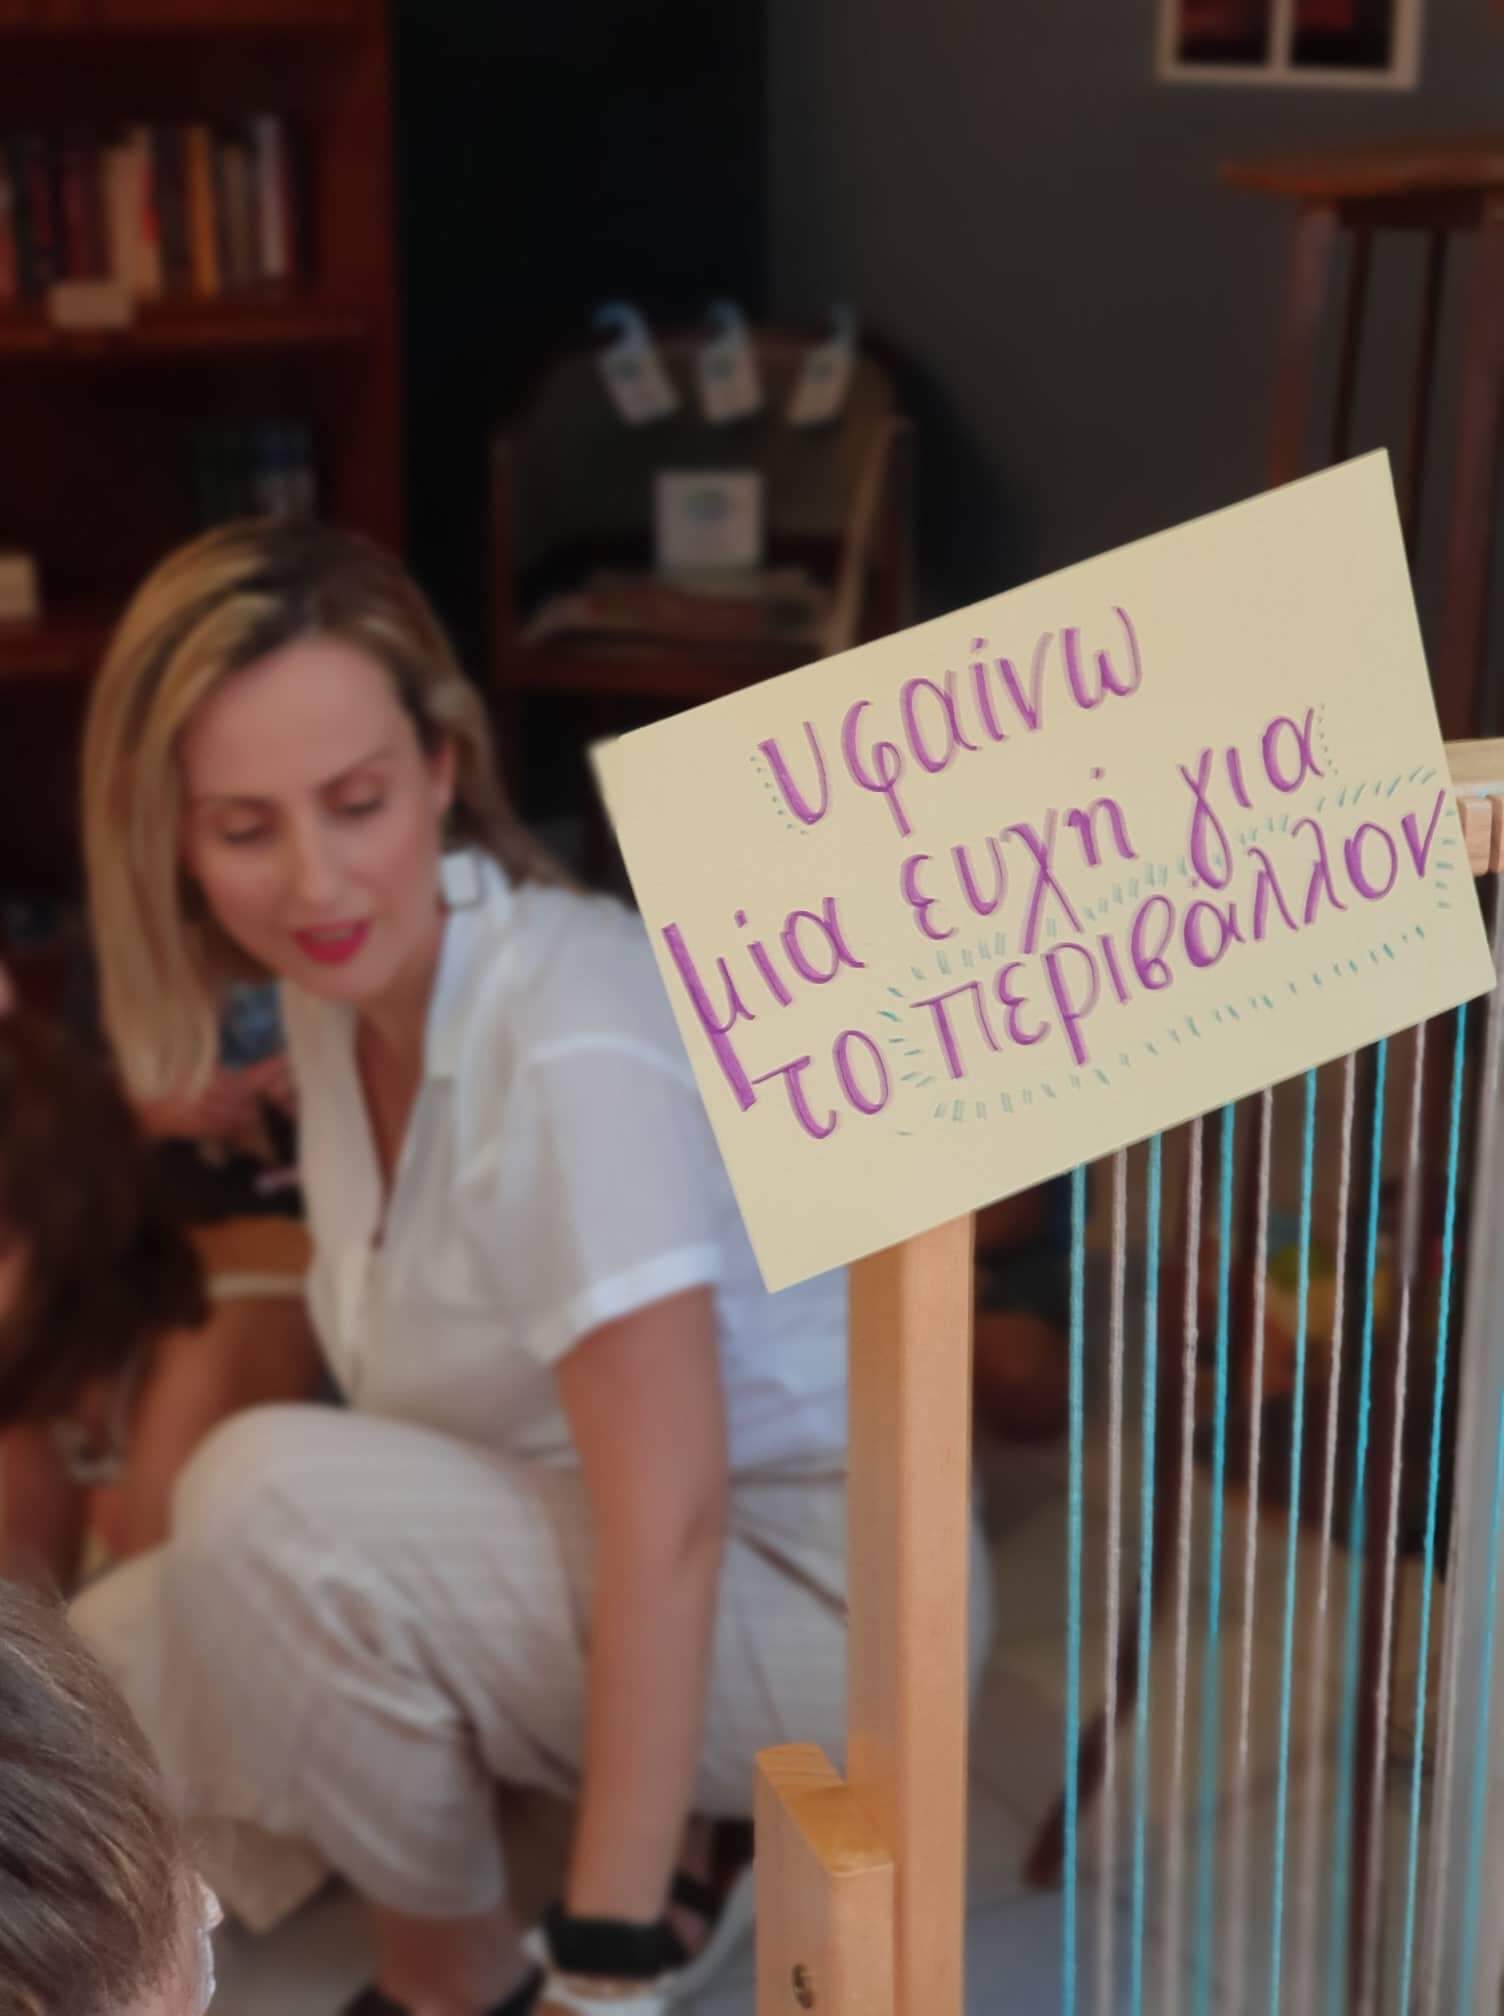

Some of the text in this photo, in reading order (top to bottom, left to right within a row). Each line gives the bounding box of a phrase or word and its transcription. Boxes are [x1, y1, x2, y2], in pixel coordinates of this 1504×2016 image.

[900, 767, 1137, 954] ευχή
[1177, 707, 1324, 890] για
[752, 1030, 890, 1139] το
